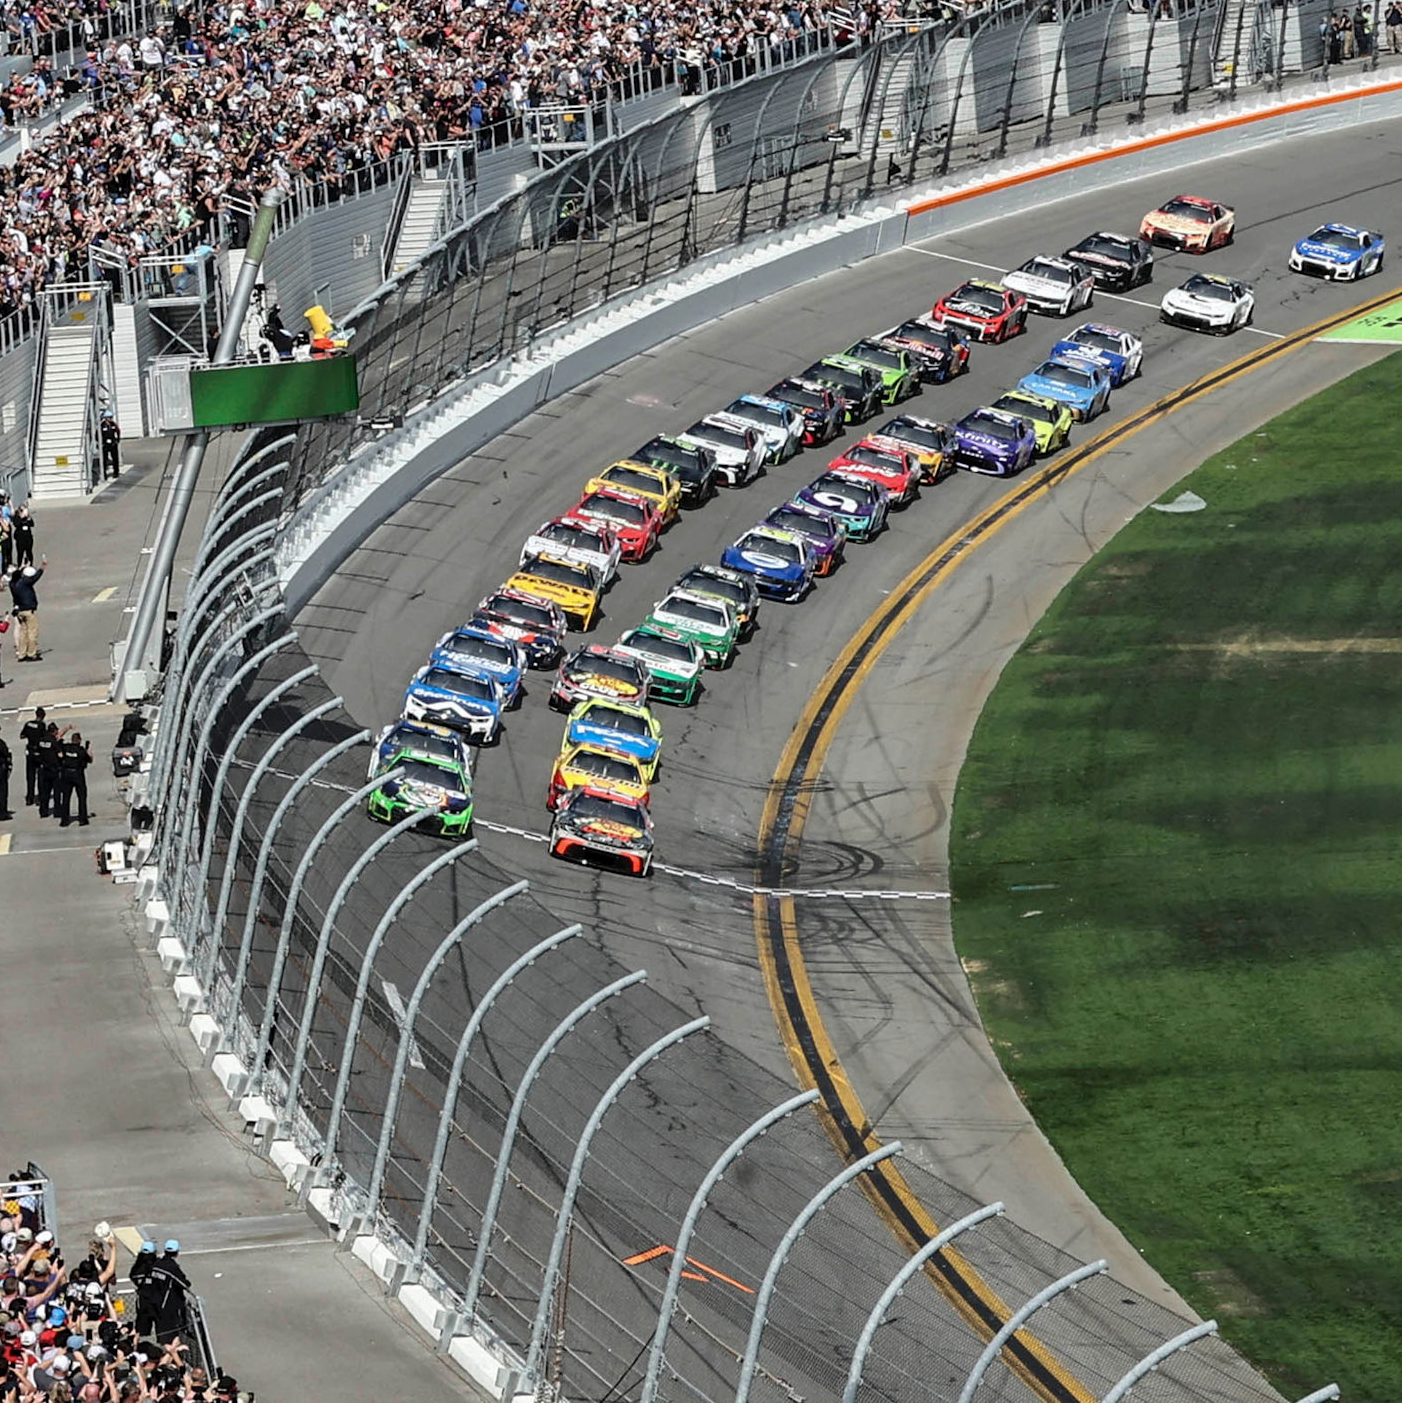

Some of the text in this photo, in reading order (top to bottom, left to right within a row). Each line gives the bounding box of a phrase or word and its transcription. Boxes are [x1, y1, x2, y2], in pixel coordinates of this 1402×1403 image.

[514, 574, 591, 599] DEWALT
[412, 687, 492, 714] Spectrum
[579, 681, 620, 698] CLUB
